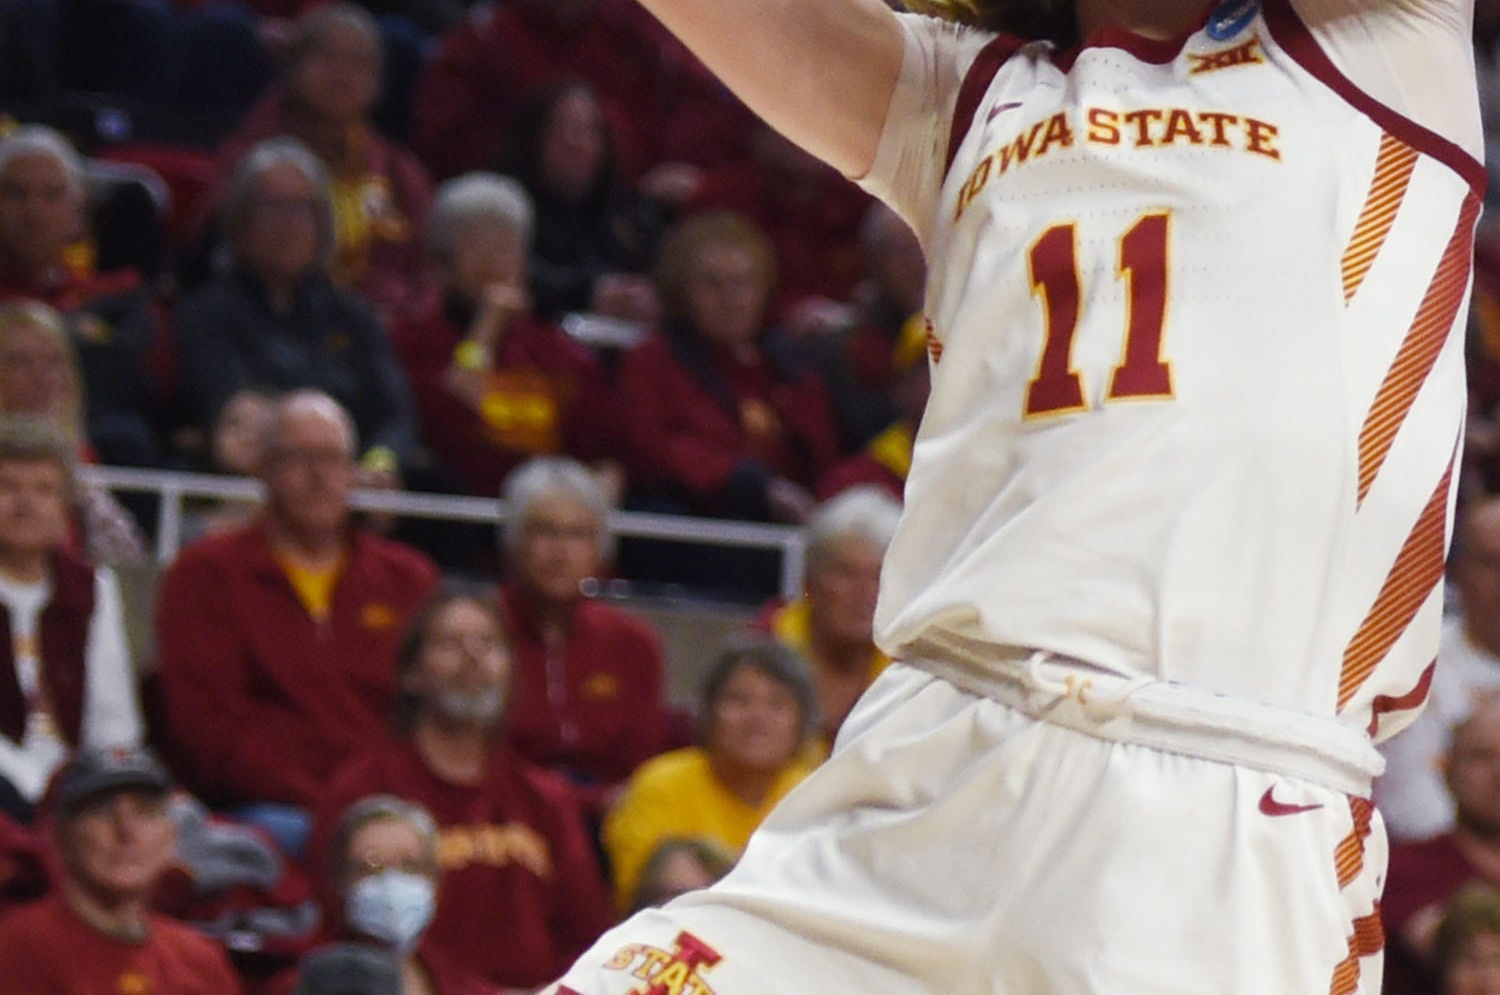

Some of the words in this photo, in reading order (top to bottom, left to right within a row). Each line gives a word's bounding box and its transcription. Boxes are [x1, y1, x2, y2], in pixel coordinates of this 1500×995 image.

[952, 108, 1076, 225] IOWA
[1086, 105, 1285, 165] STATE
[1021, 207, 1177, 423] 11
